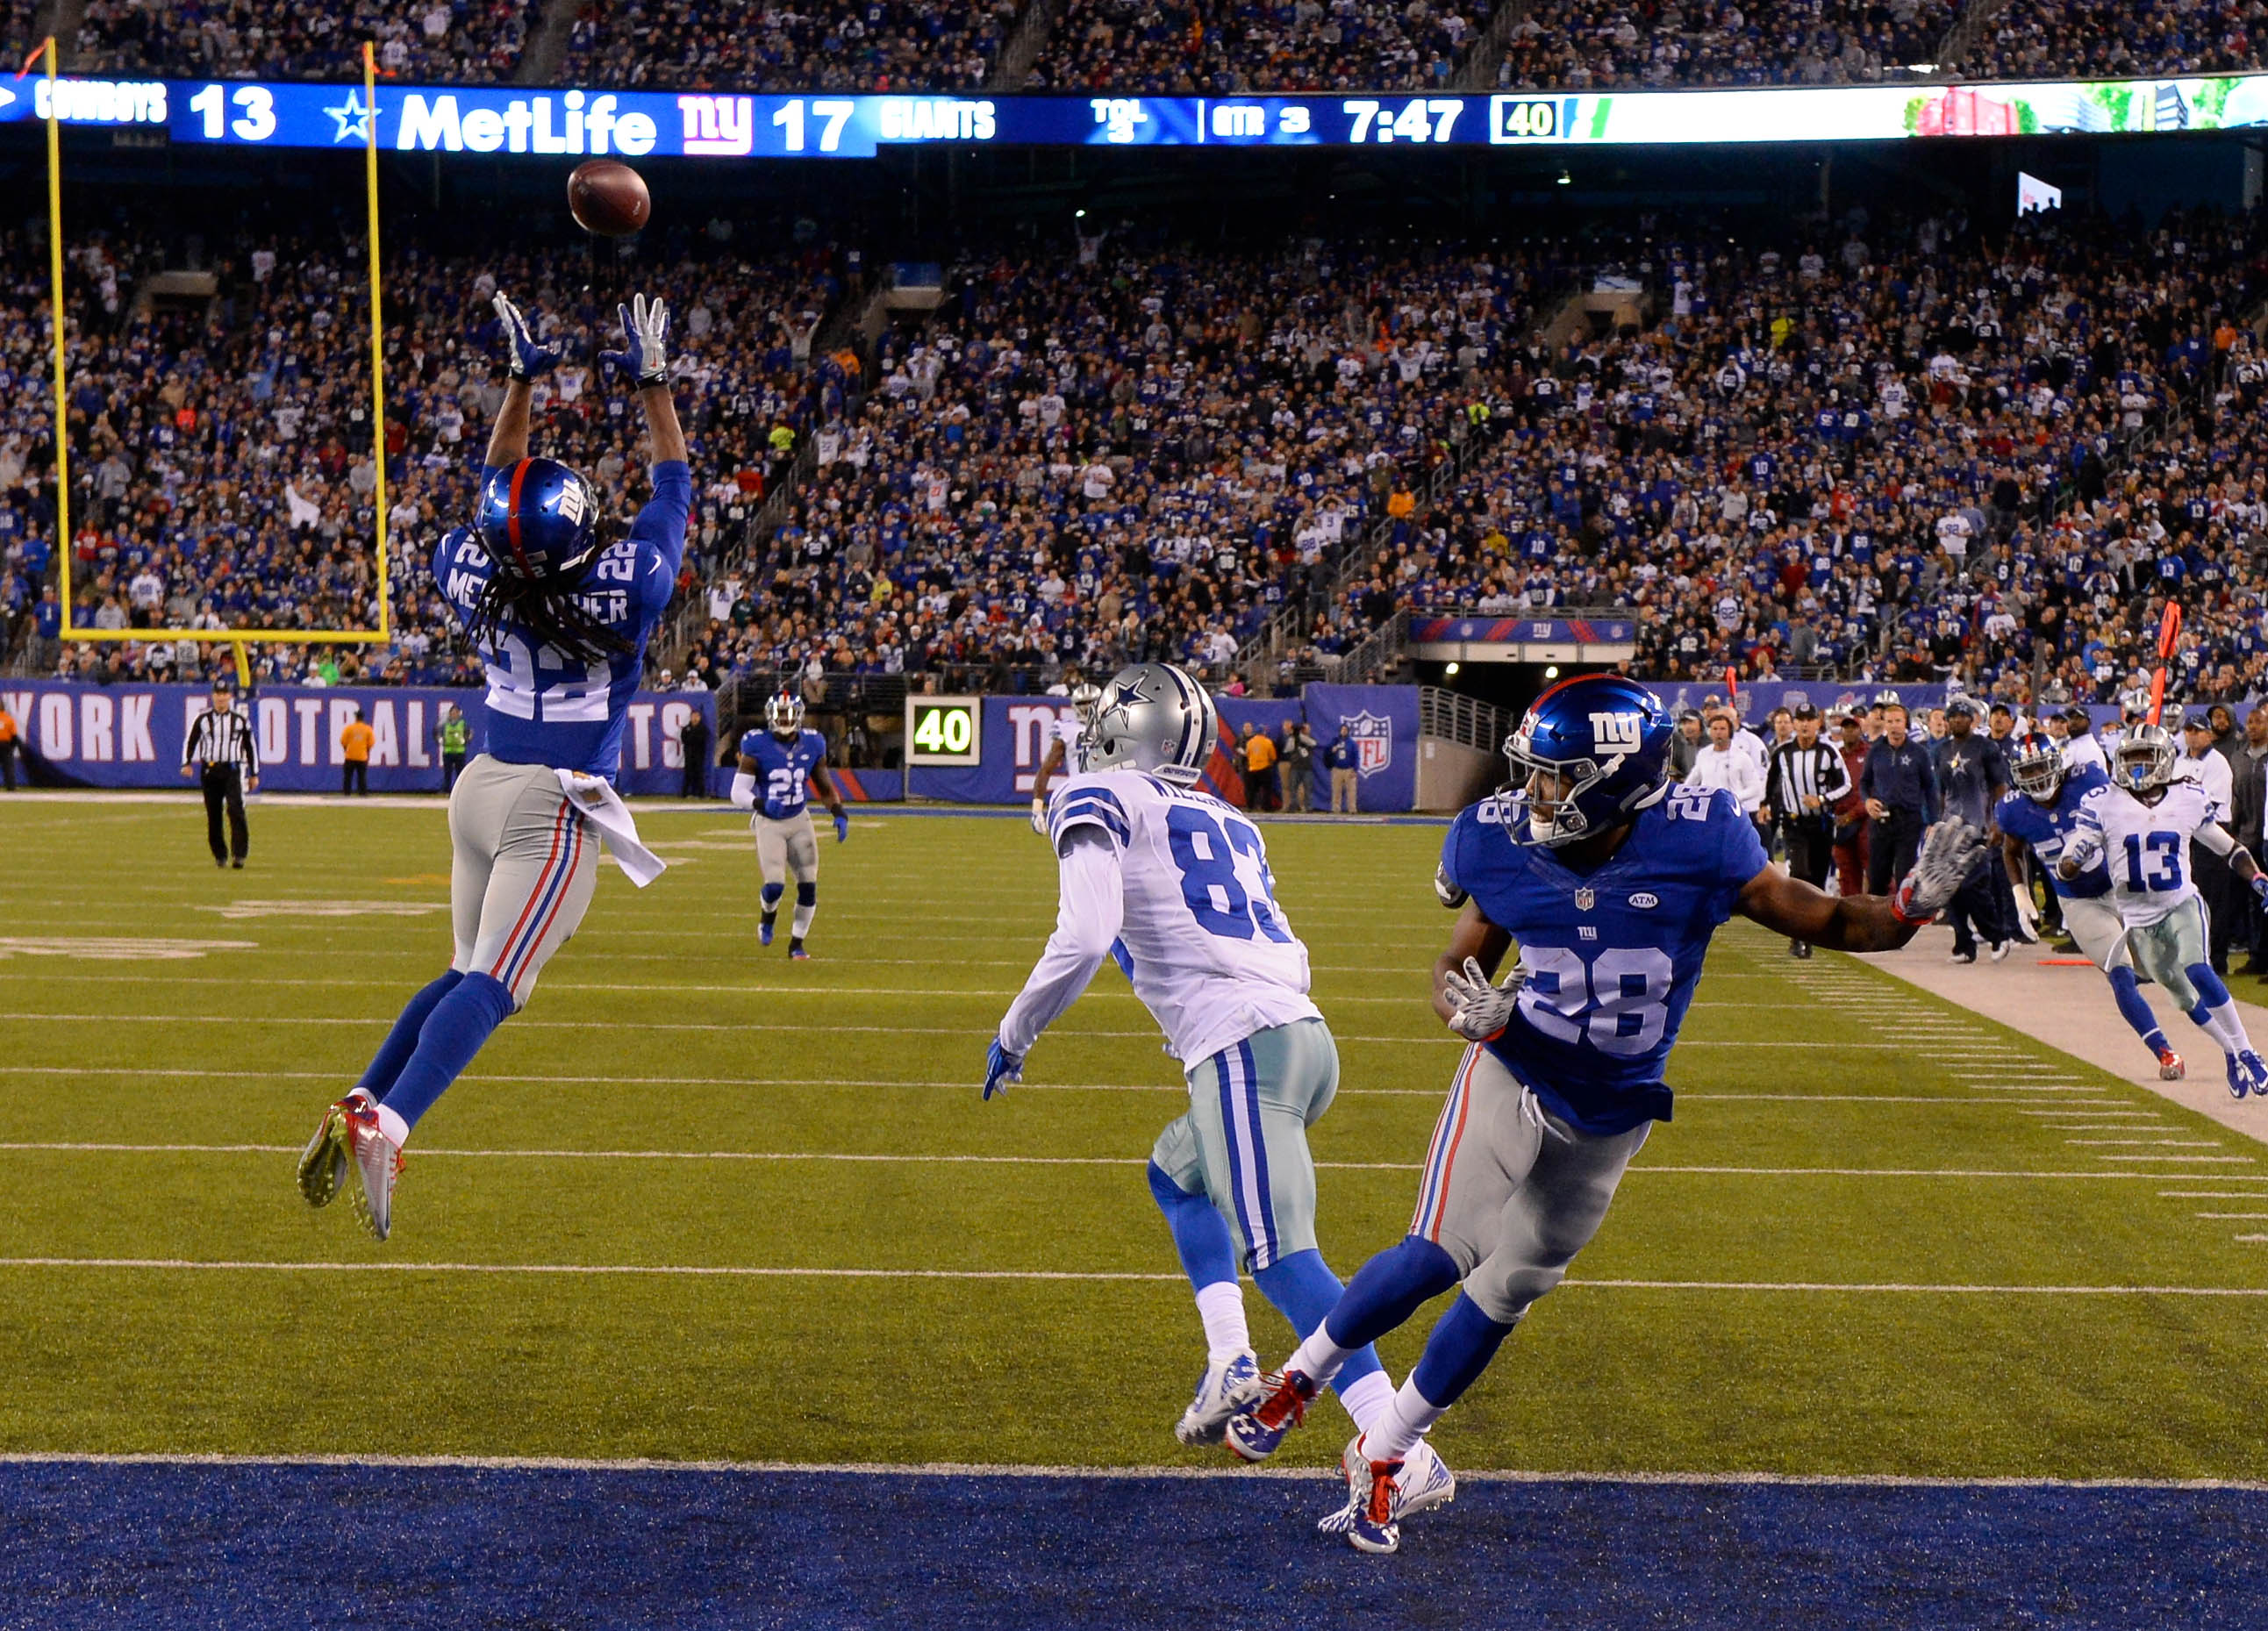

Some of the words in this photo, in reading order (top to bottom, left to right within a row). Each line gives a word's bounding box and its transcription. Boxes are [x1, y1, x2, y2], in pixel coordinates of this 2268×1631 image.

[190, 84, 276, 139] 13
[397, 90, 656, 155] MetLife
[773, 99, 855, 152] 17
[879, 100, 996, 140] GIANTS
[1280, 107, 1310, 132] 3
[1343, 99, 1463, 143] 7:47
[1506, 103, 1553, 136] 40
[1755, 461, 1769, 476] 10
[2191, 504, 2205, 519] 13
[1531, 540, 1545, 554] 10
[2068, 556, 2082, 572] 10
[2162, 564, 2175, 576] 13
[2, 691, 156, 762] YORK
[914, 708, 971, 752] 40
[1588, 712, 1642, 754] ny
[768, 767, 805, 805] 21
[2123, 831, 2183, 892] 13
[1632, 896, 1656, 905] ATM
[1517, 948, 1672, 1055] 28
